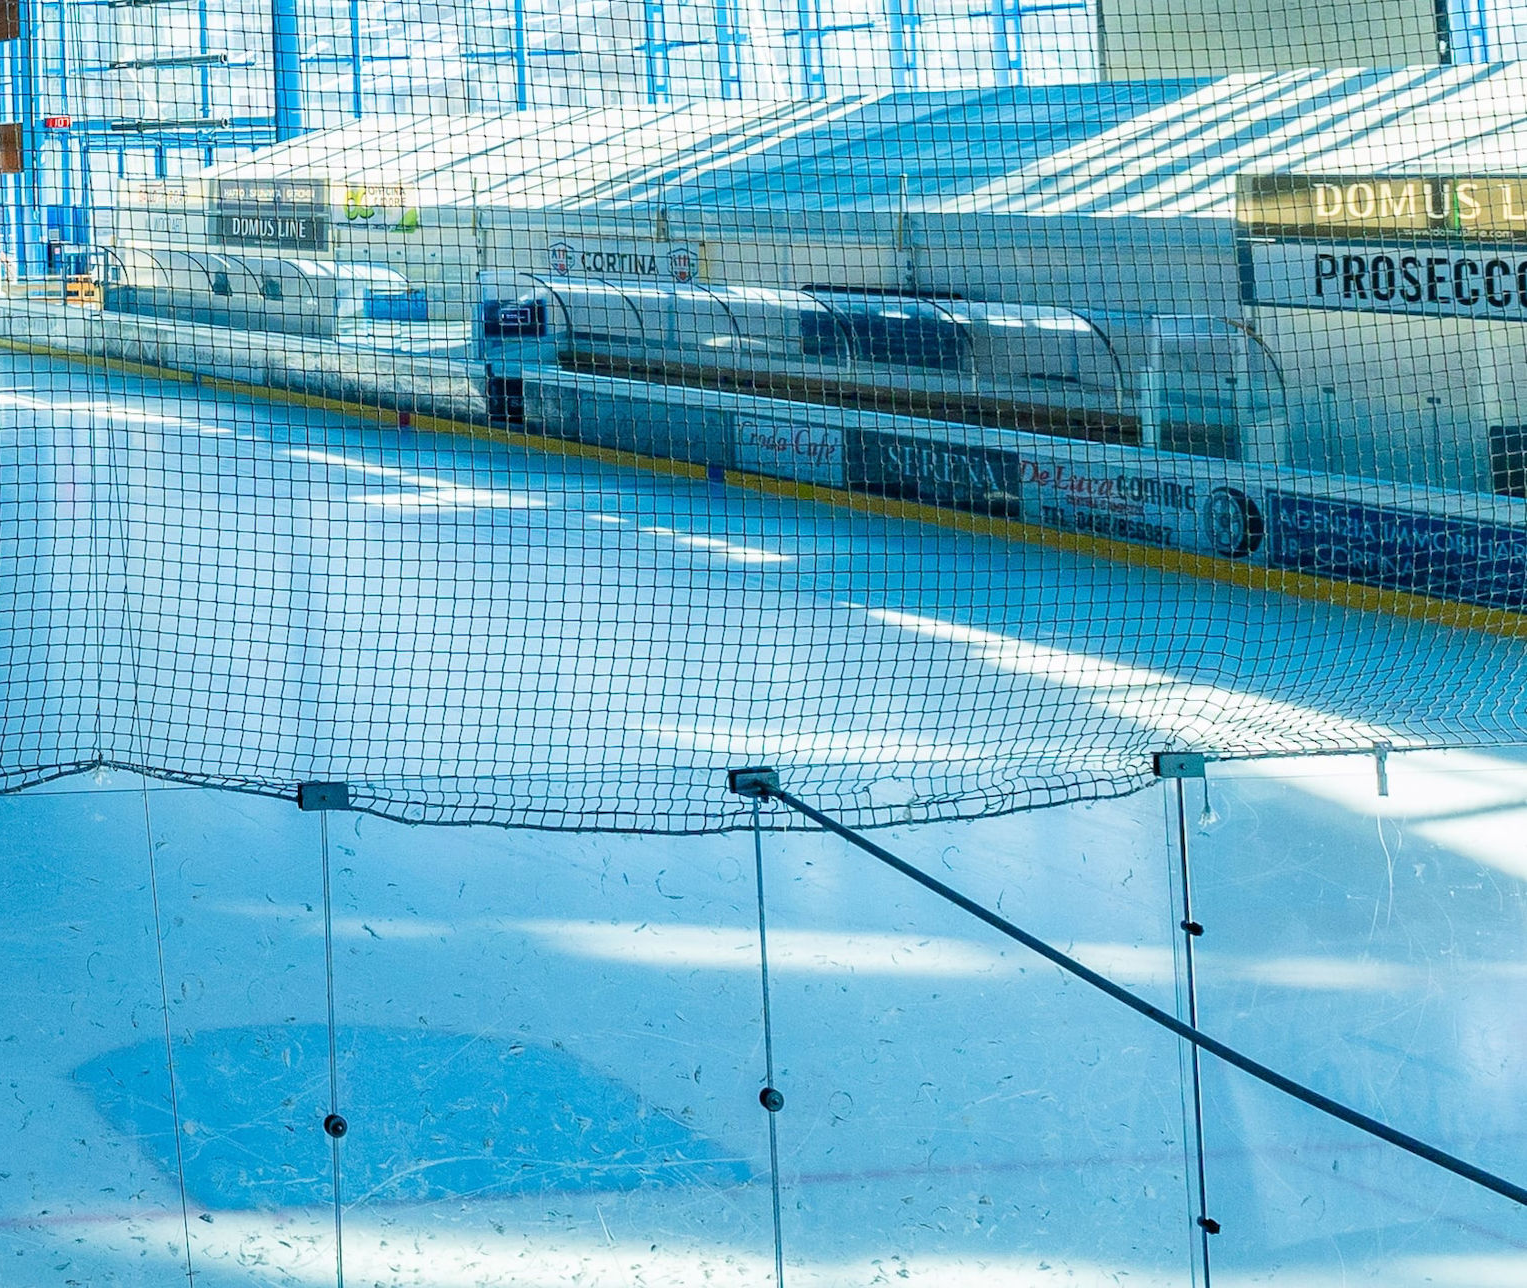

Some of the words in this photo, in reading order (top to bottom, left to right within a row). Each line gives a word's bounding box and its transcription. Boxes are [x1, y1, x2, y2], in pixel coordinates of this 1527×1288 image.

[1313, 182, 1481, 220] DOMUS
[232, 217, 275, 237] DOMUS
[277, 218, 306, 238] LINE
[581, 252, 658, 275] CORTINA
[887, 445, 999, 491] SERENA
[1277, 508, 1376, 541] AGENZIA
[1315, 544, 1414, 577] CORTINA
